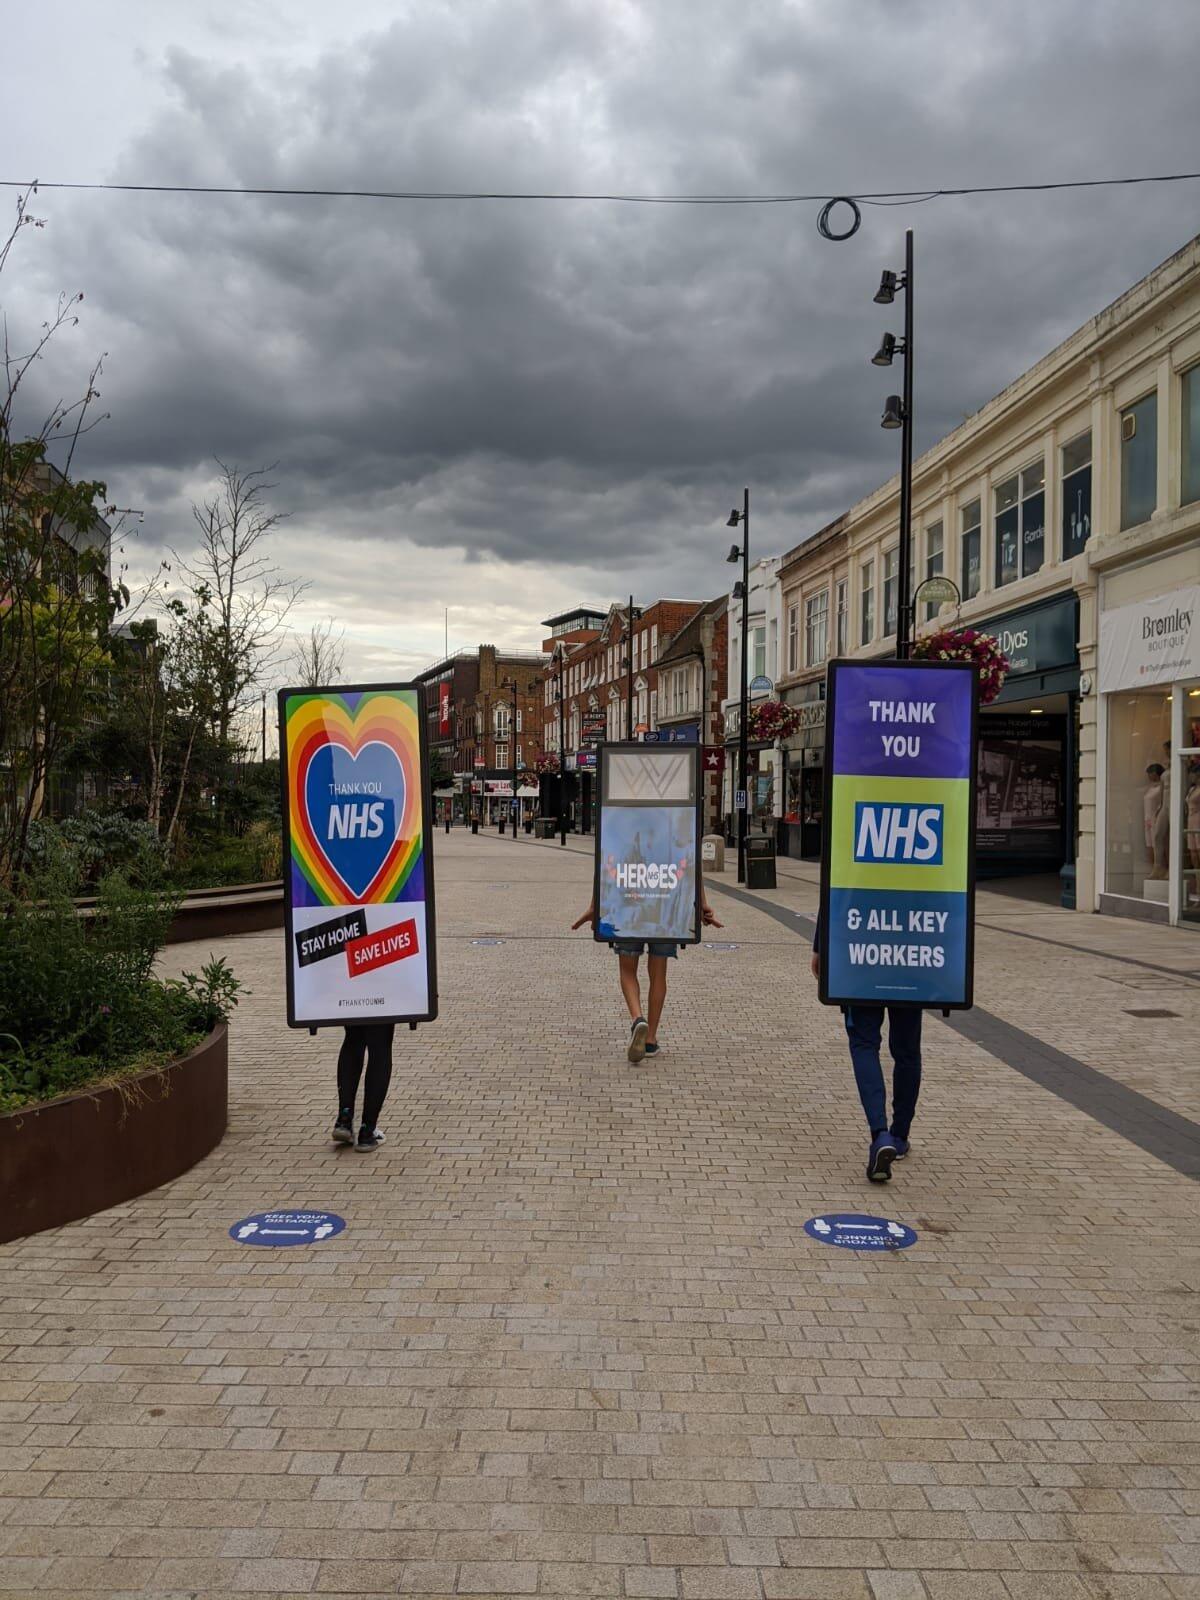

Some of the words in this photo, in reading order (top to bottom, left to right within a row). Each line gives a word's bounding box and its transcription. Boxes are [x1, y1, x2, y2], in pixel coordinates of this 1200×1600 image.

[1142, 608, 1194, 640] Bromley
[1003, 630, 1028, 655] Dyas
[1148, 635, 1185, 652] BOUTIQUE
[869, 700, 936, 724] THANK
[882, 735, 921, 758] YOU
[329, 783, 360, 795] THANK
[363, 782, 382, 793] YOU
[328, 802, 384, 839] NHS
[856, 807, 941, 861] NHS
[616, 863, 678, 889] HEROES
[847, 908, 862, 930] &
[866, 909, 903, 931] ALL
[908, 910, 949, 933] KEY
[301, 934, 326, 956] STAY
[328, 921, 360, 946] HOME
[354, 943, 381, 965] SAVE
[382, 932, 411, 955] LIVES
[848, 943, 945, 968] WORKERS
[338, 998, 385, 1007] #THANKYOUNHS
